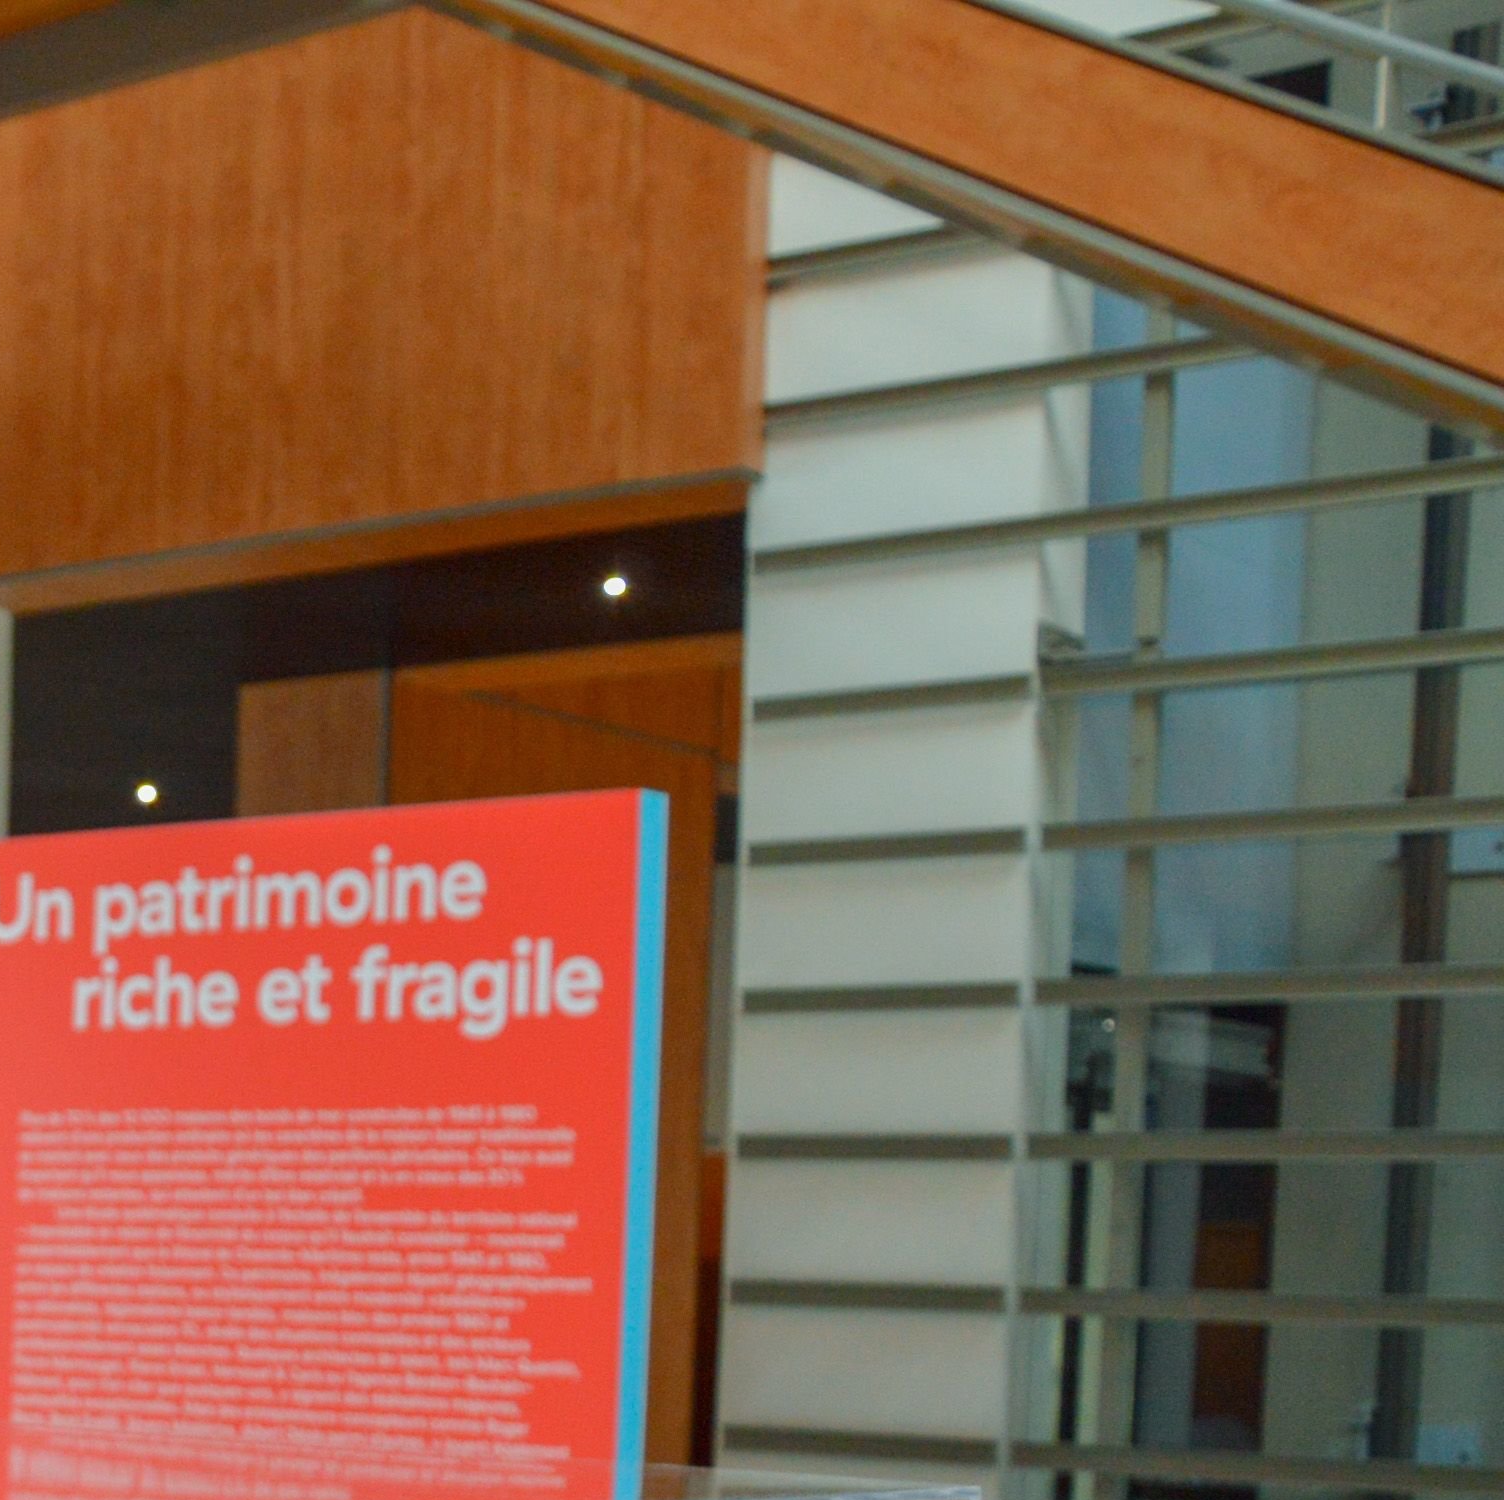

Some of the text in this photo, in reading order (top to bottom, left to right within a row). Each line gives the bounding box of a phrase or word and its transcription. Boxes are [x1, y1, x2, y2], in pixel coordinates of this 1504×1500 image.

[92, 844, 487, 955] patrimoine
[73, 936, 604, 1040] riche et fragile
